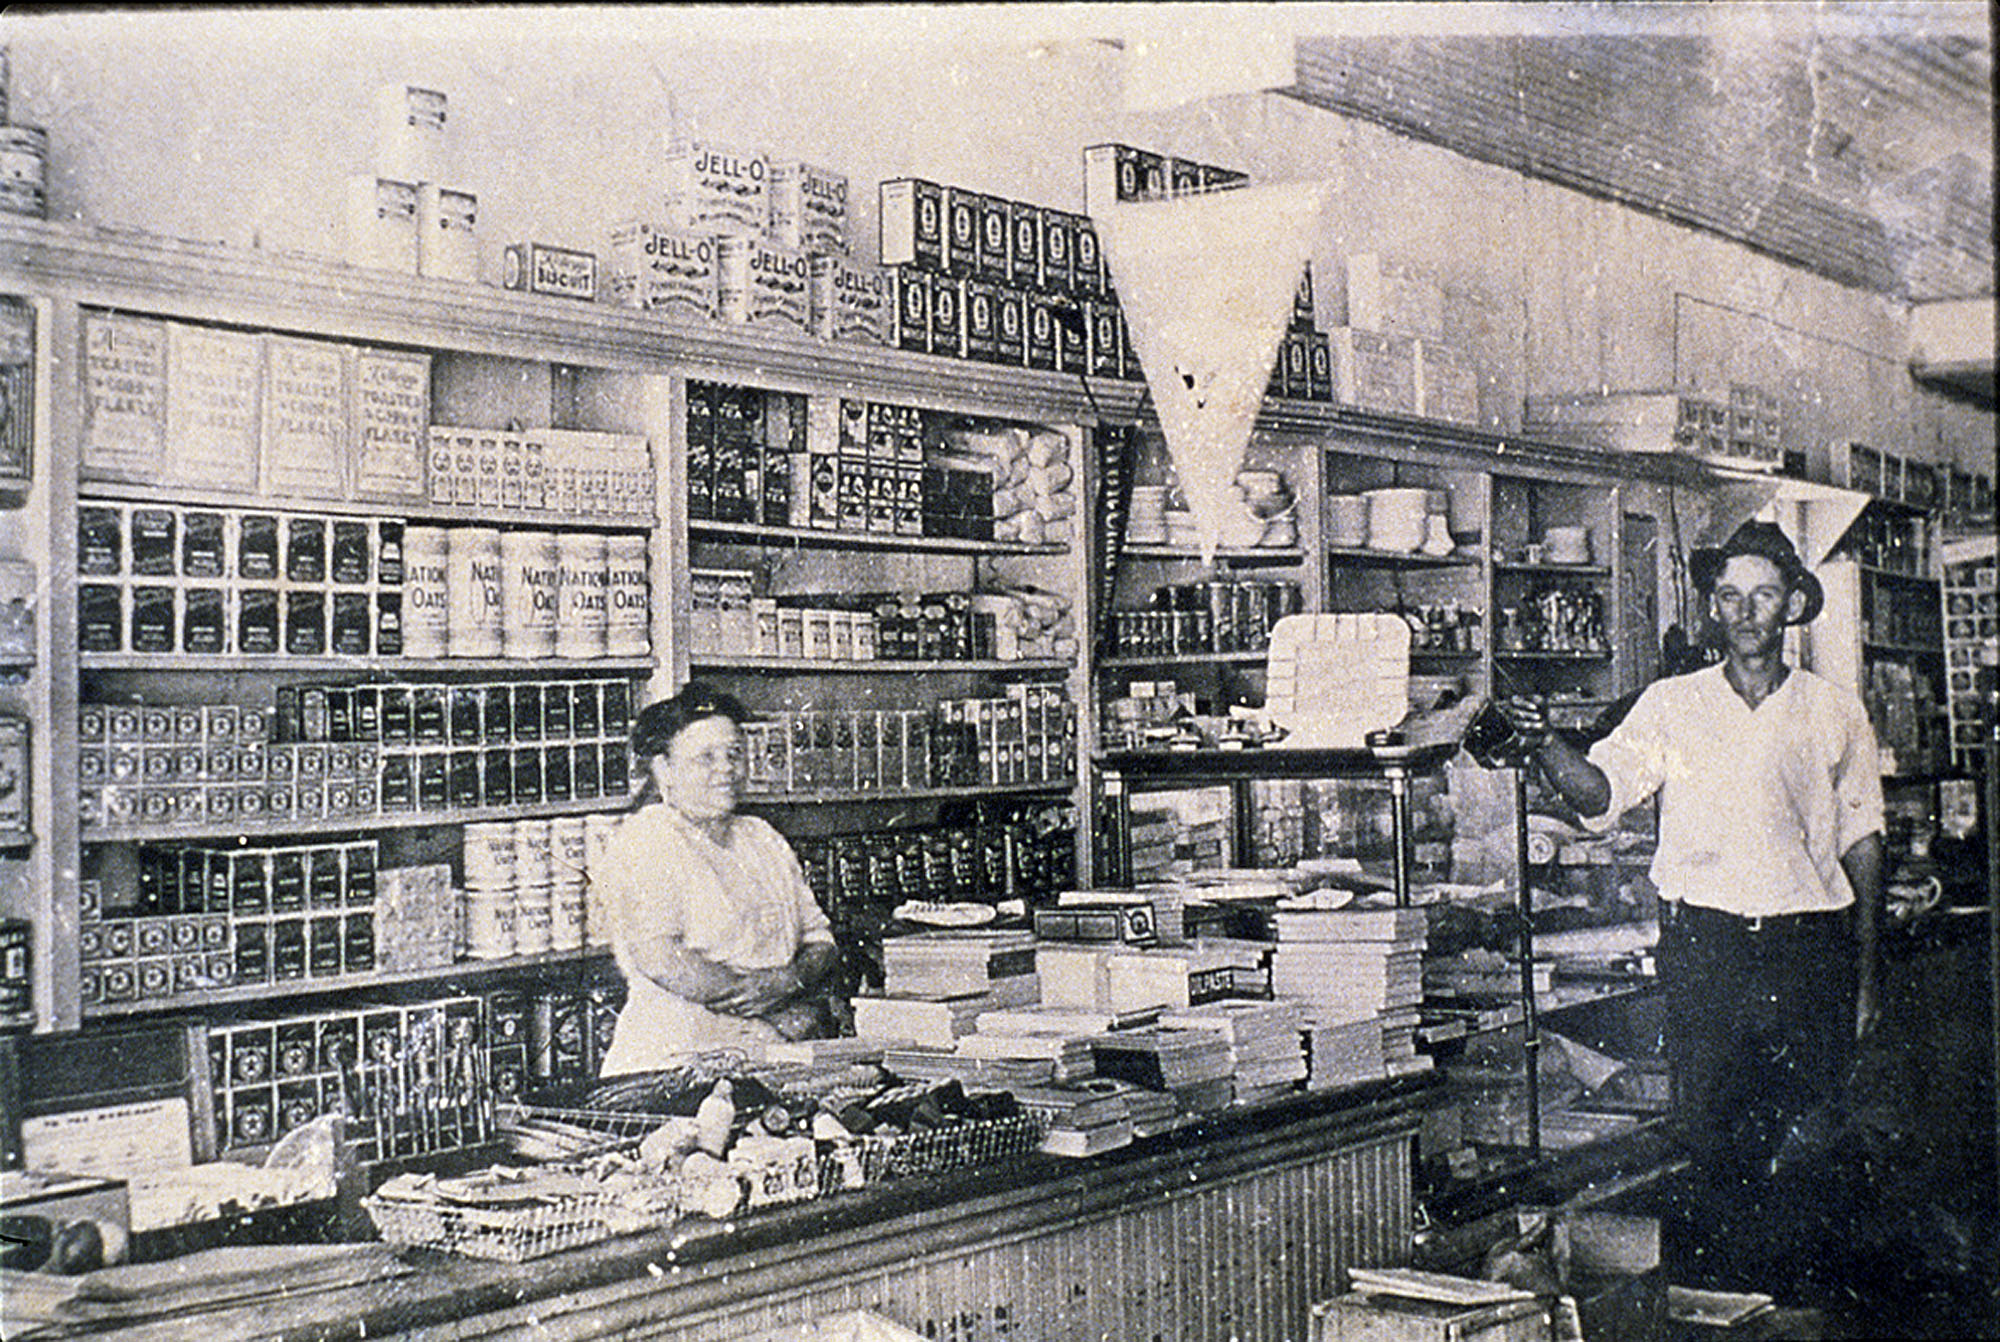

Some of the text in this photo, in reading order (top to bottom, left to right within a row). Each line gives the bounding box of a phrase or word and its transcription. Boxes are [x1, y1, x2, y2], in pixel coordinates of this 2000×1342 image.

[695, 152, 764, 181] JELL-O
[802, 174, 847, 202] JELL-O
[645, 235, 711, 264] JELL-O
[751, 251, 807, 279] JELL-O
[834, 268, 882, 296] JELL-O
